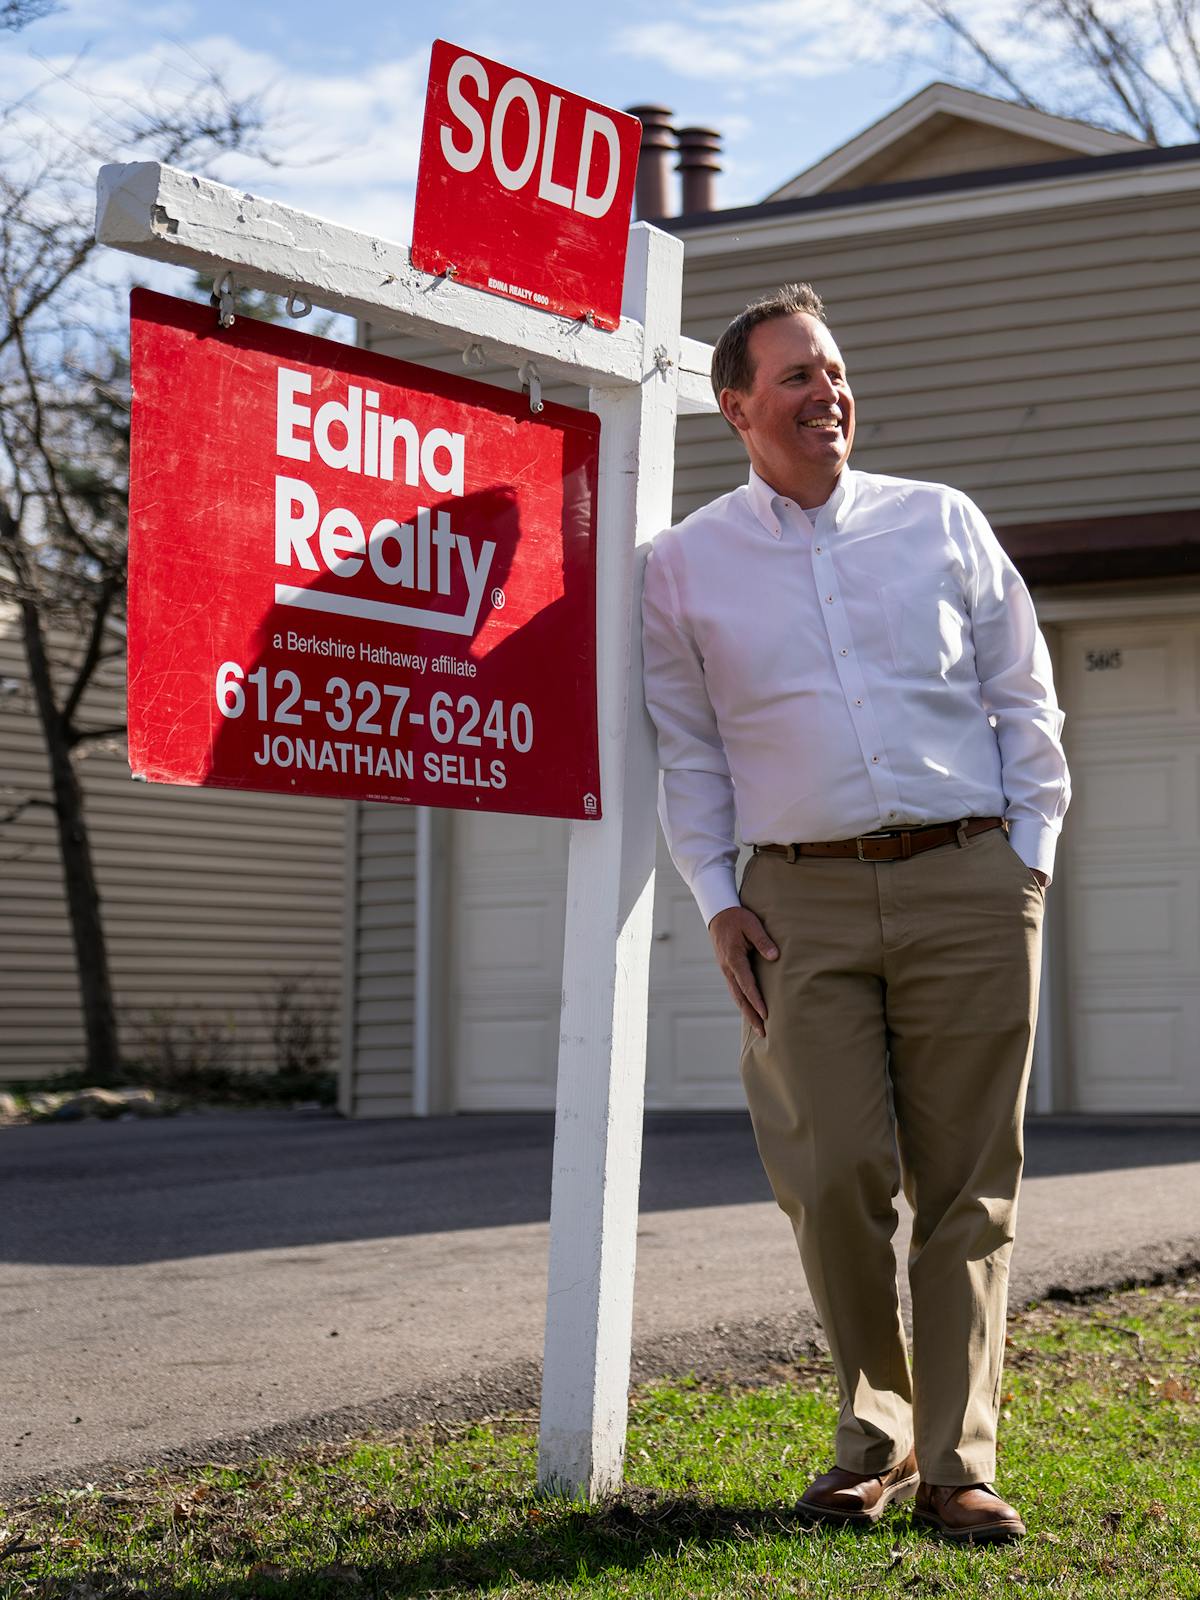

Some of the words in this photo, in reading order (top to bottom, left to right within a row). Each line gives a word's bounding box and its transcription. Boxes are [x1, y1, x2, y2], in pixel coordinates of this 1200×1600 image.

[440, 55, 621, 219] SOLD
[488, 277, 508, 293] EDINA
[508, 284, 533, 300] REALTY
[275, 366, 466, 498] Edina
[274, 475, 497, 636] Realty
[273, 633, 283, 649] a
[287, 631, 356, 660] Berkshire
[359, 642, 428, 675] Hathaway
[431, 655, 477, 678] affiliate
[215, 660, 534, 754] 612-327-6240
[254, 734, 415, 780] JONATHAN
[423, 752, 507, 789] SELLS
